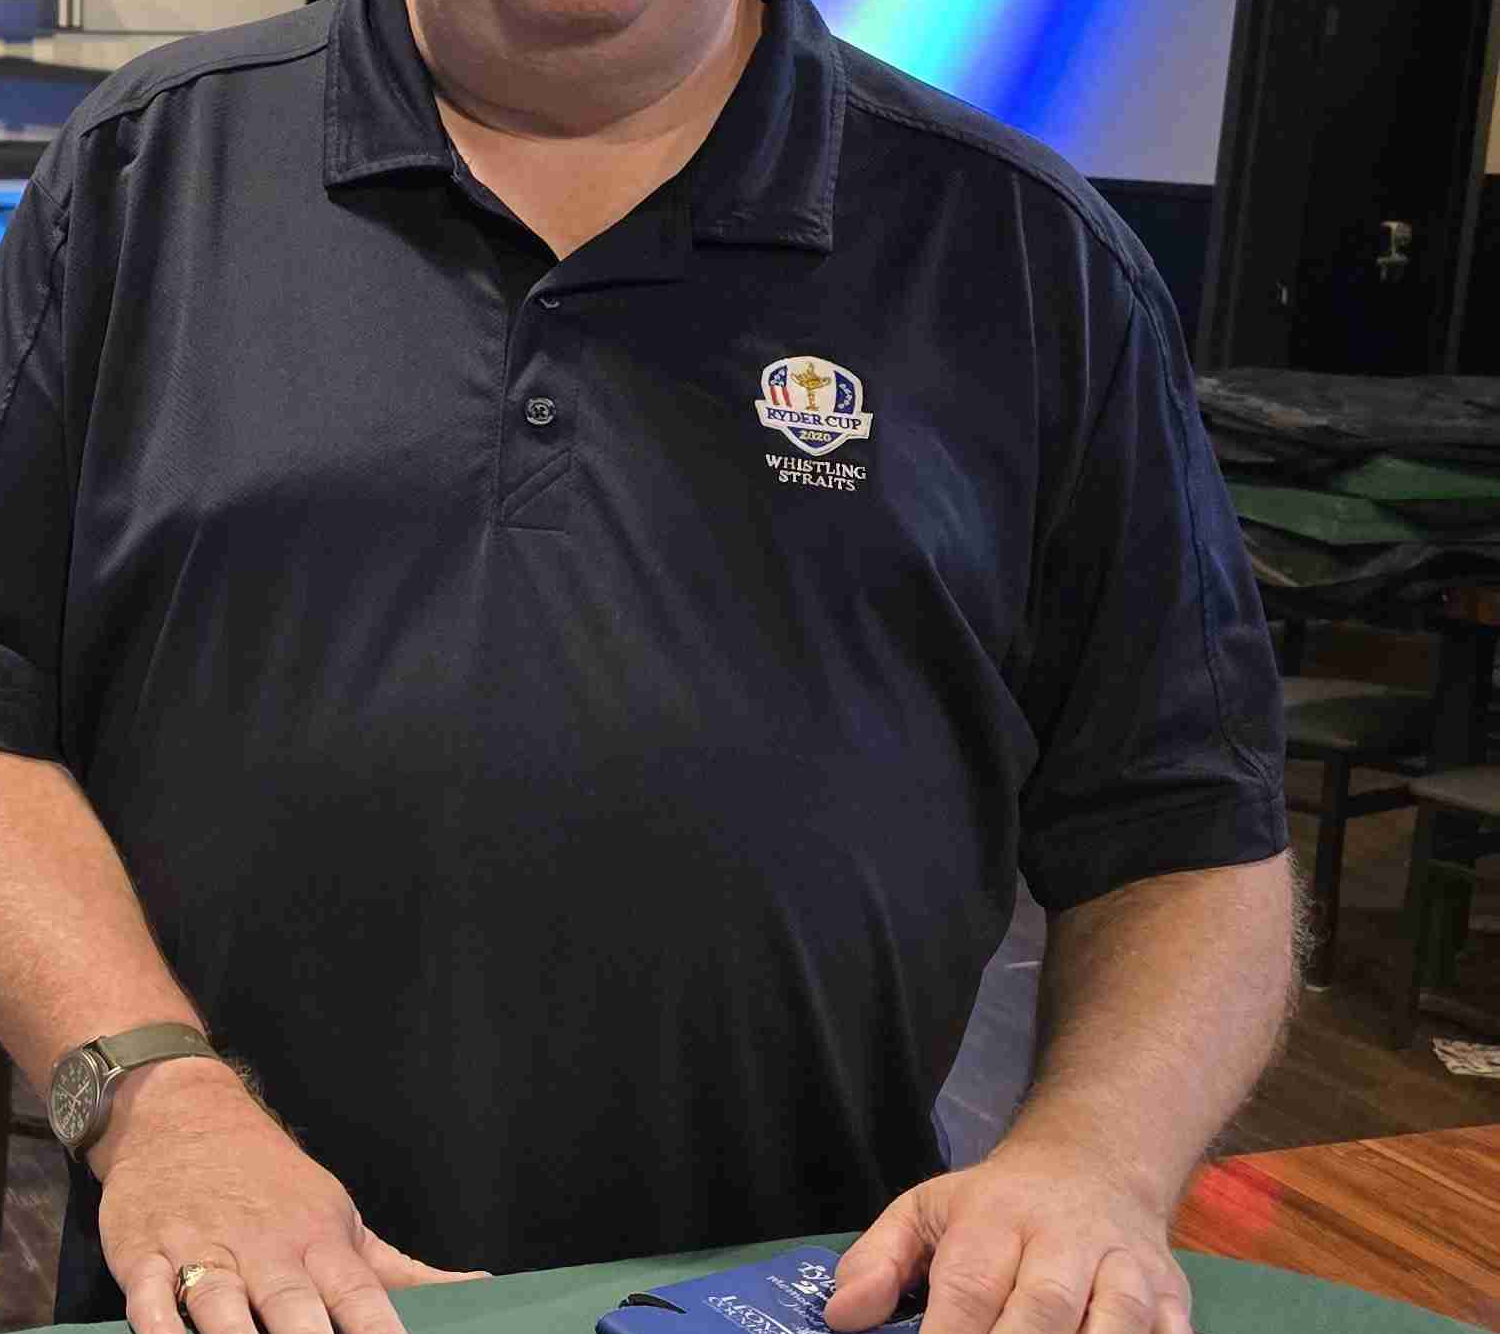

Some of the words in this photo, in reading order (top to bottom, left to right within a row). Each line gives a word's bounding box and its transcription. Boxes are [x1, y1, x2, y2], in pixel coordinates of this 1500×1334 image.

[765, 407, 822, 427] RYDER
[825, 416, 862, 430] CUP
[799, 430, 832, 443] 2020
[765, 454, 867, 480] WHISTLING
[778, 470, 857, 492] STRAITS
